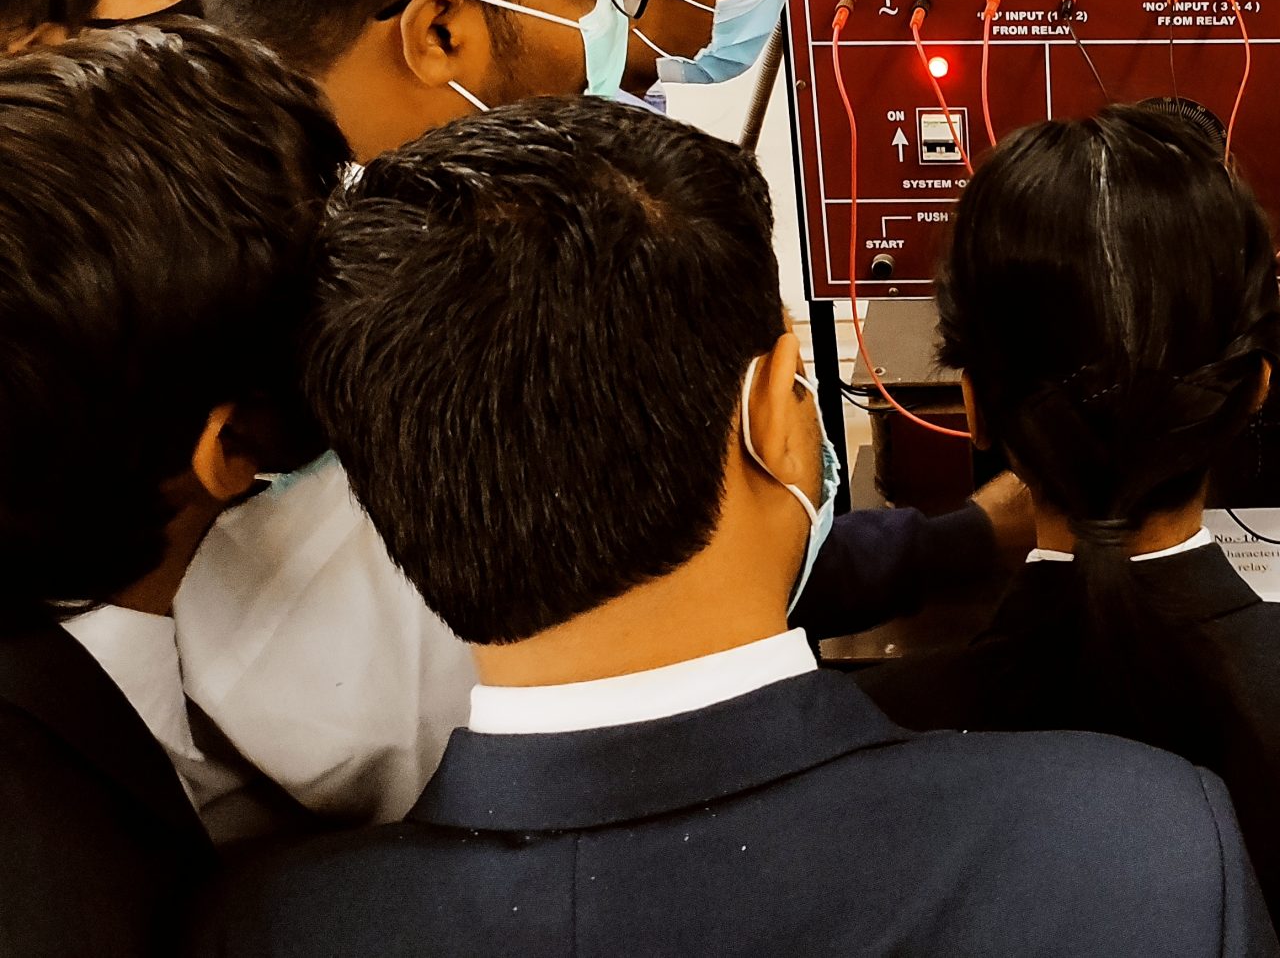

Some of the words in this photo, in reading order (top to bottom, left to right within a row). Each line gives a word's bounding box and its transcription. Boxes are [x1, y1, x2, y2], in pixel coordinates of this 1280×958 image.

[1142, 1, 1168, 12] 'NO'
[1005, 11, 1044, 21] INPUT
[1157, 16, 1193, 26] FROM
[1196, 16, 1236, 26] RELAY
[992, 25, 1028, 35] FROM
[1031, 25, 1070, 35] RELAY
[887, 110, 905, 122] ON
[902, 179, 952, 189] SYSTEM
[917, 212, 949, 222] PUSH
[865, 239, 905, 249] START
